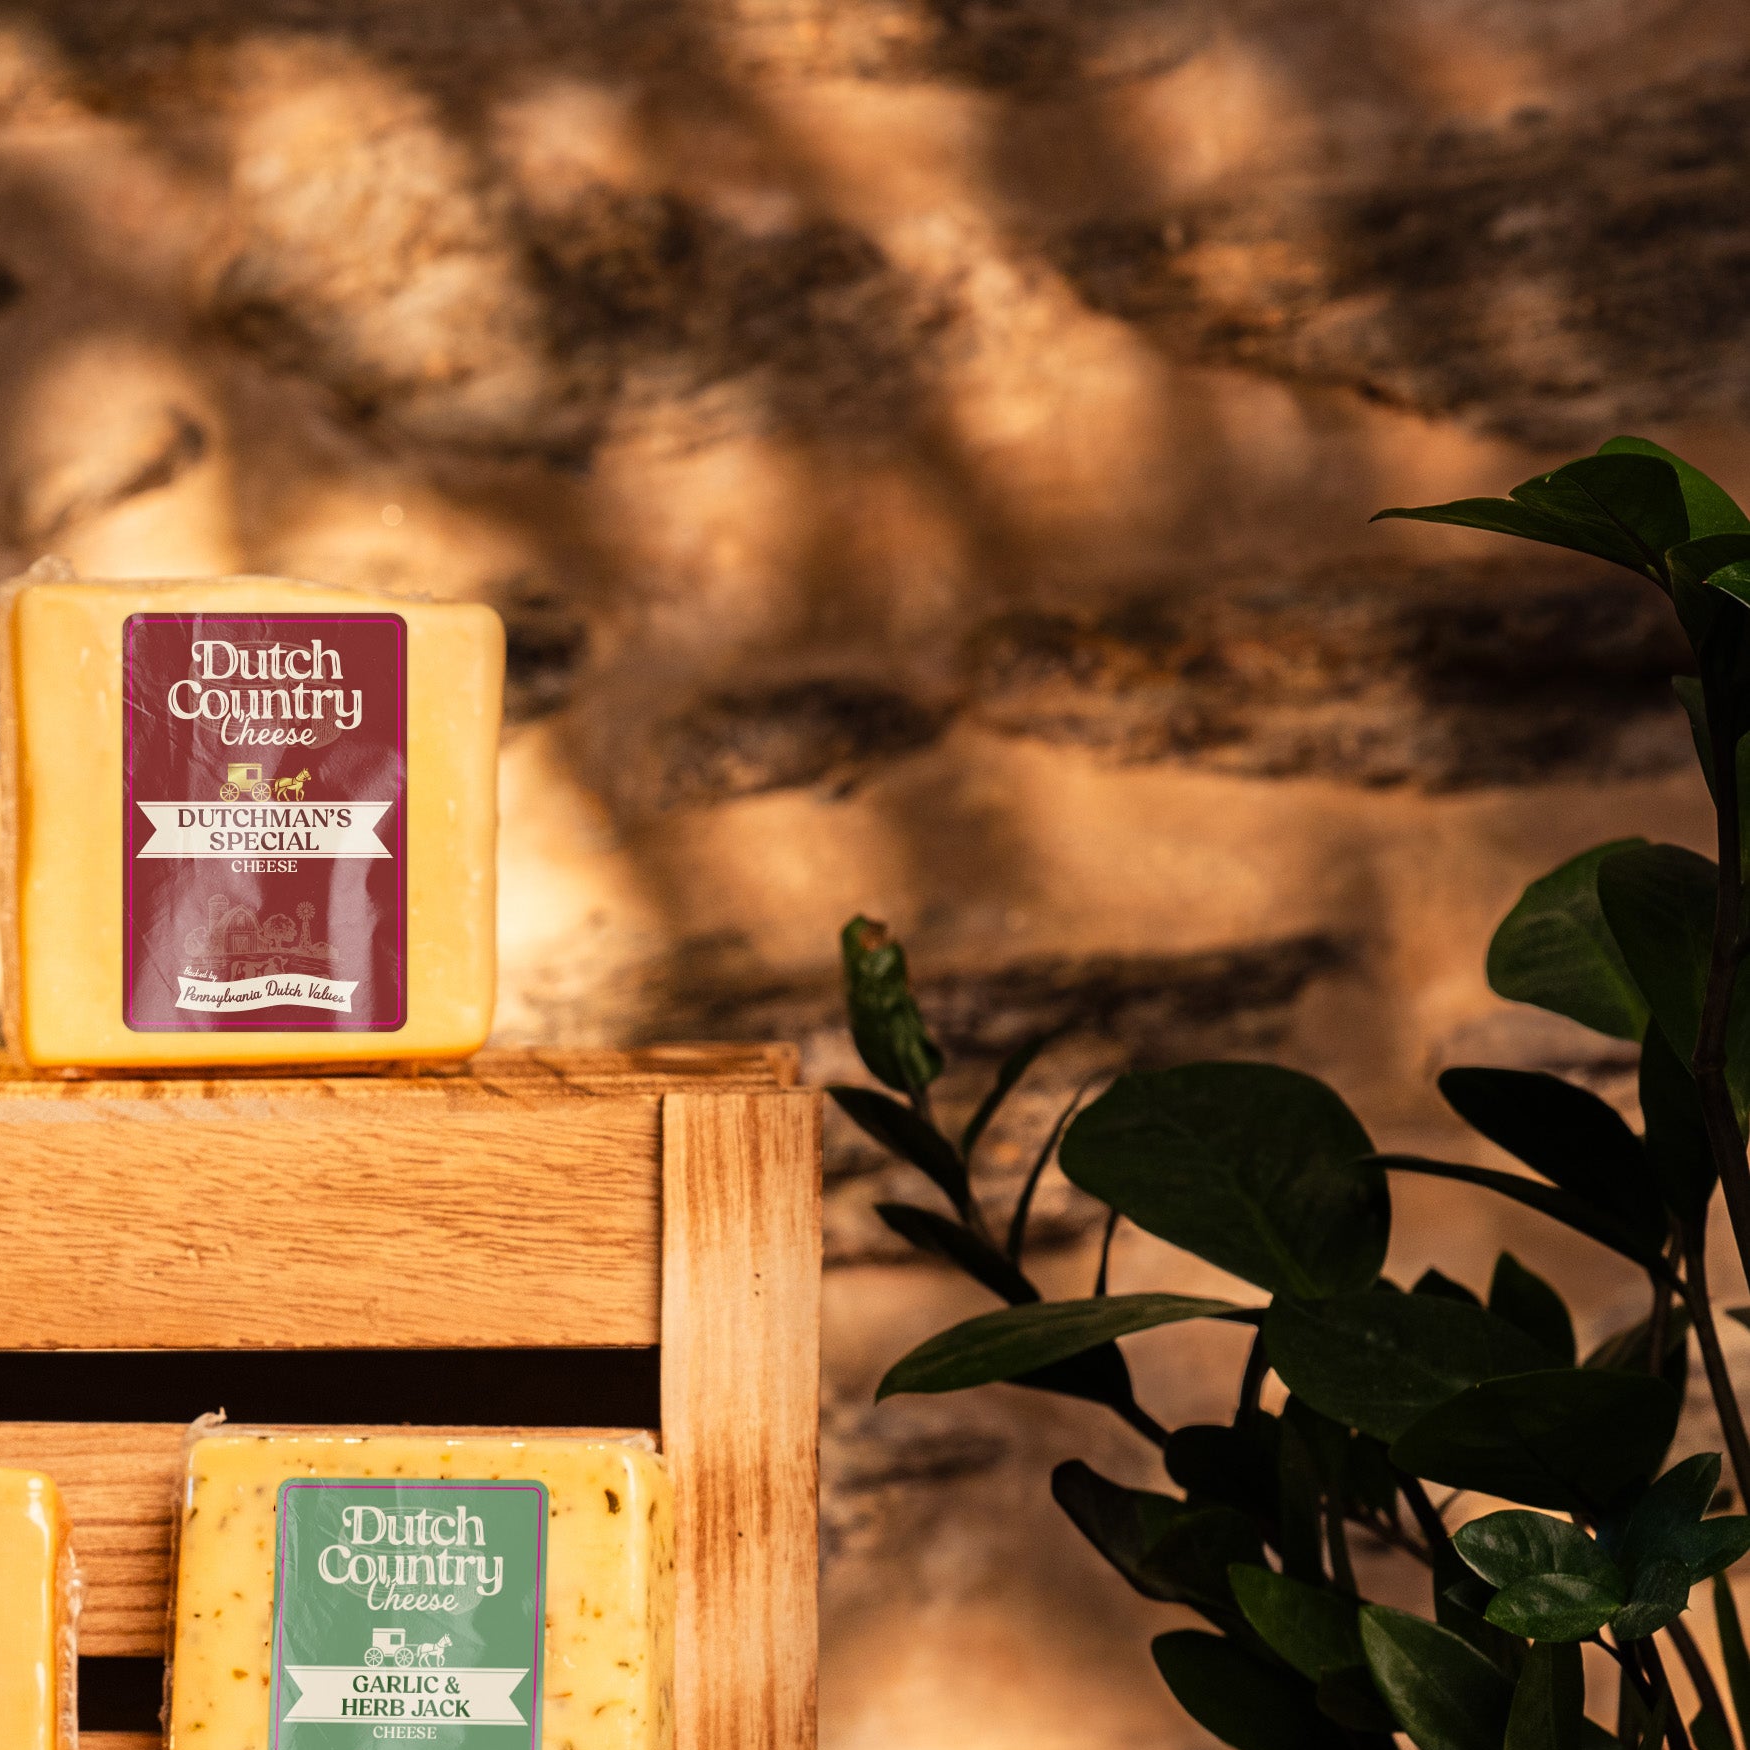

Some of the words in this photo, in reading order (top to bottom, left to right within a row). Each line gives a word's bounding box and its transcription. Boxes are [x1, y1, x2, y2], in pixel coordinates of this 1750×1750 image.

[192, 639, 343, 680] Dutch
[167, 679, 362, 730] Country
[220, 712, 317, 746] Cheese
[178, 808, 352, 828] DUTCHMAN'S
[209, 831, 319, 851] SPECIAL
[231, 860, 298, 873] CHEESE
[184, 967, 208, 979] Backed
[208, 971, 217, 982] by
[183, 986, 262, 1008] Pennsylvania
[265, 980, 302, 997] Dutch
[308, 983, 345, 1003] Values
[342, 1506, 485, 1546] Dutch
[318, 1544, 504, 1596] Country
[366, 1578, 459, 1612] Cheese
[352, 1675, 439, 1694] GARLIC
[444, 1676, 461, 1695] &
[341, 1699, 405, 1717] HERB
[411, 1699, 470, 1718] JACK
[373, 1726, 437, 1740] CHEESE
